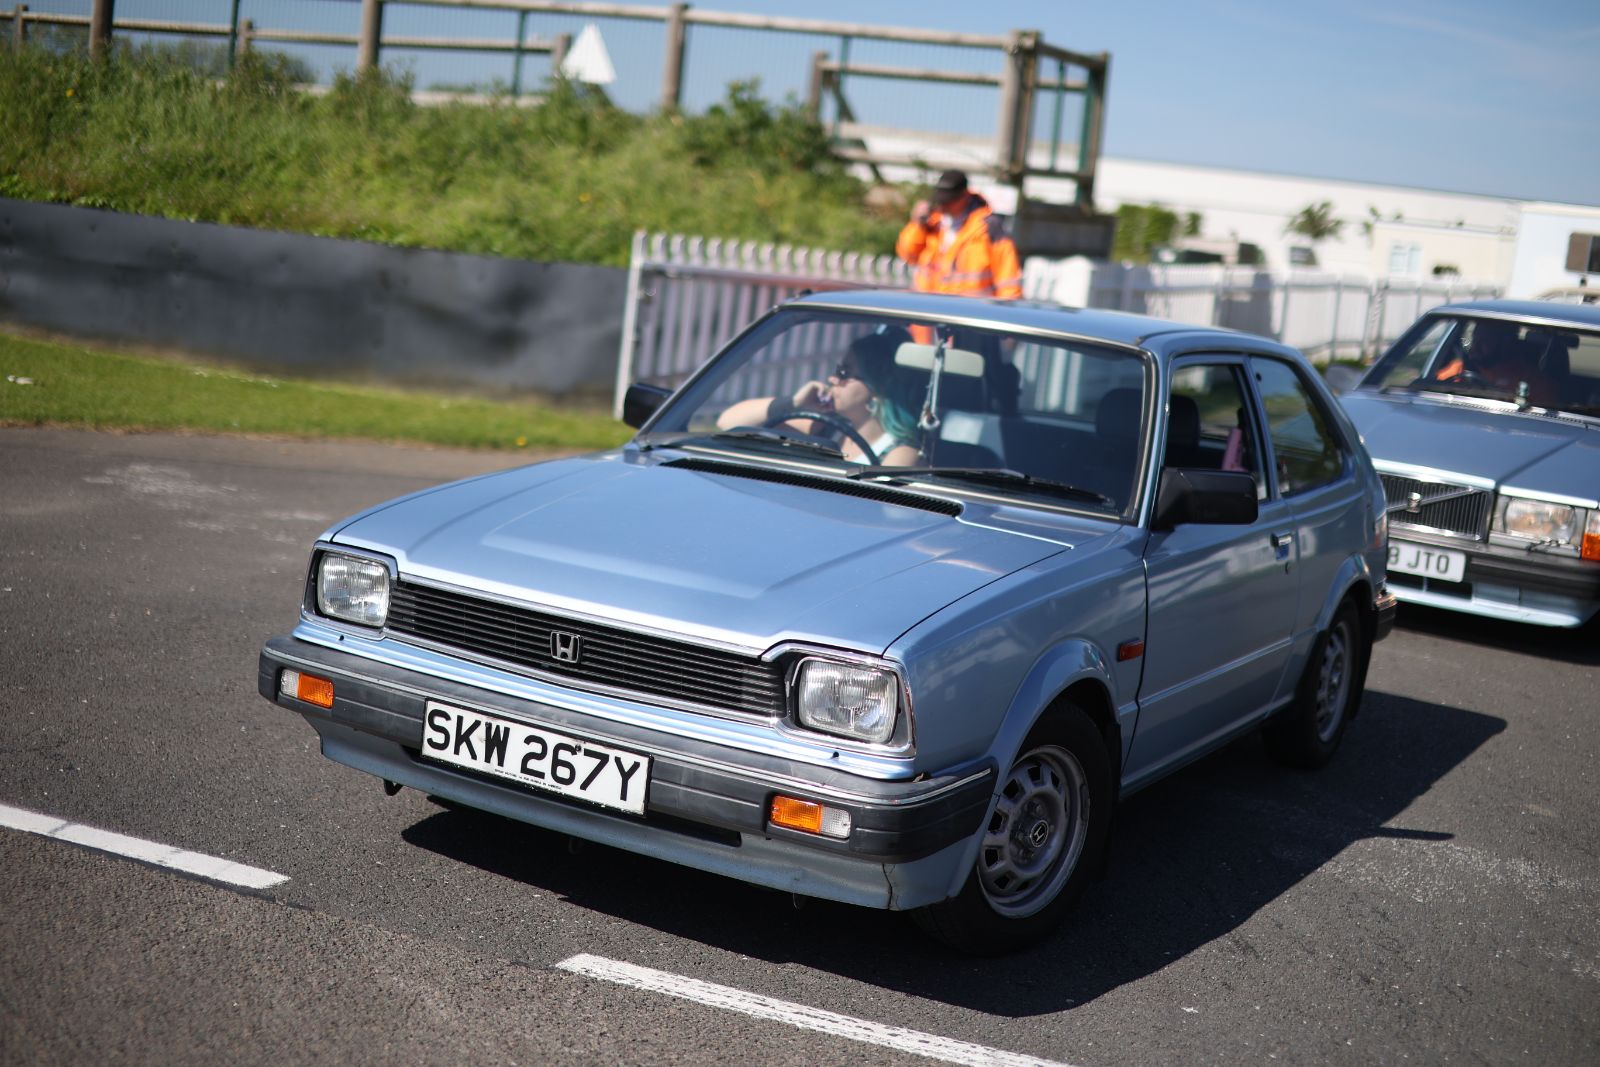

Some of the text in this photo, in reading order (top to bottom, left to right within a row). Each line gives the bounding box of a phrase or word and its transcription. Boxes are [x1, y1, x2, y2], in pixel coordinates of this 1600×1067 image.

[1407, 550, 1450, 574] JTO
[427, 709, 641, 801] SKW 267Y
